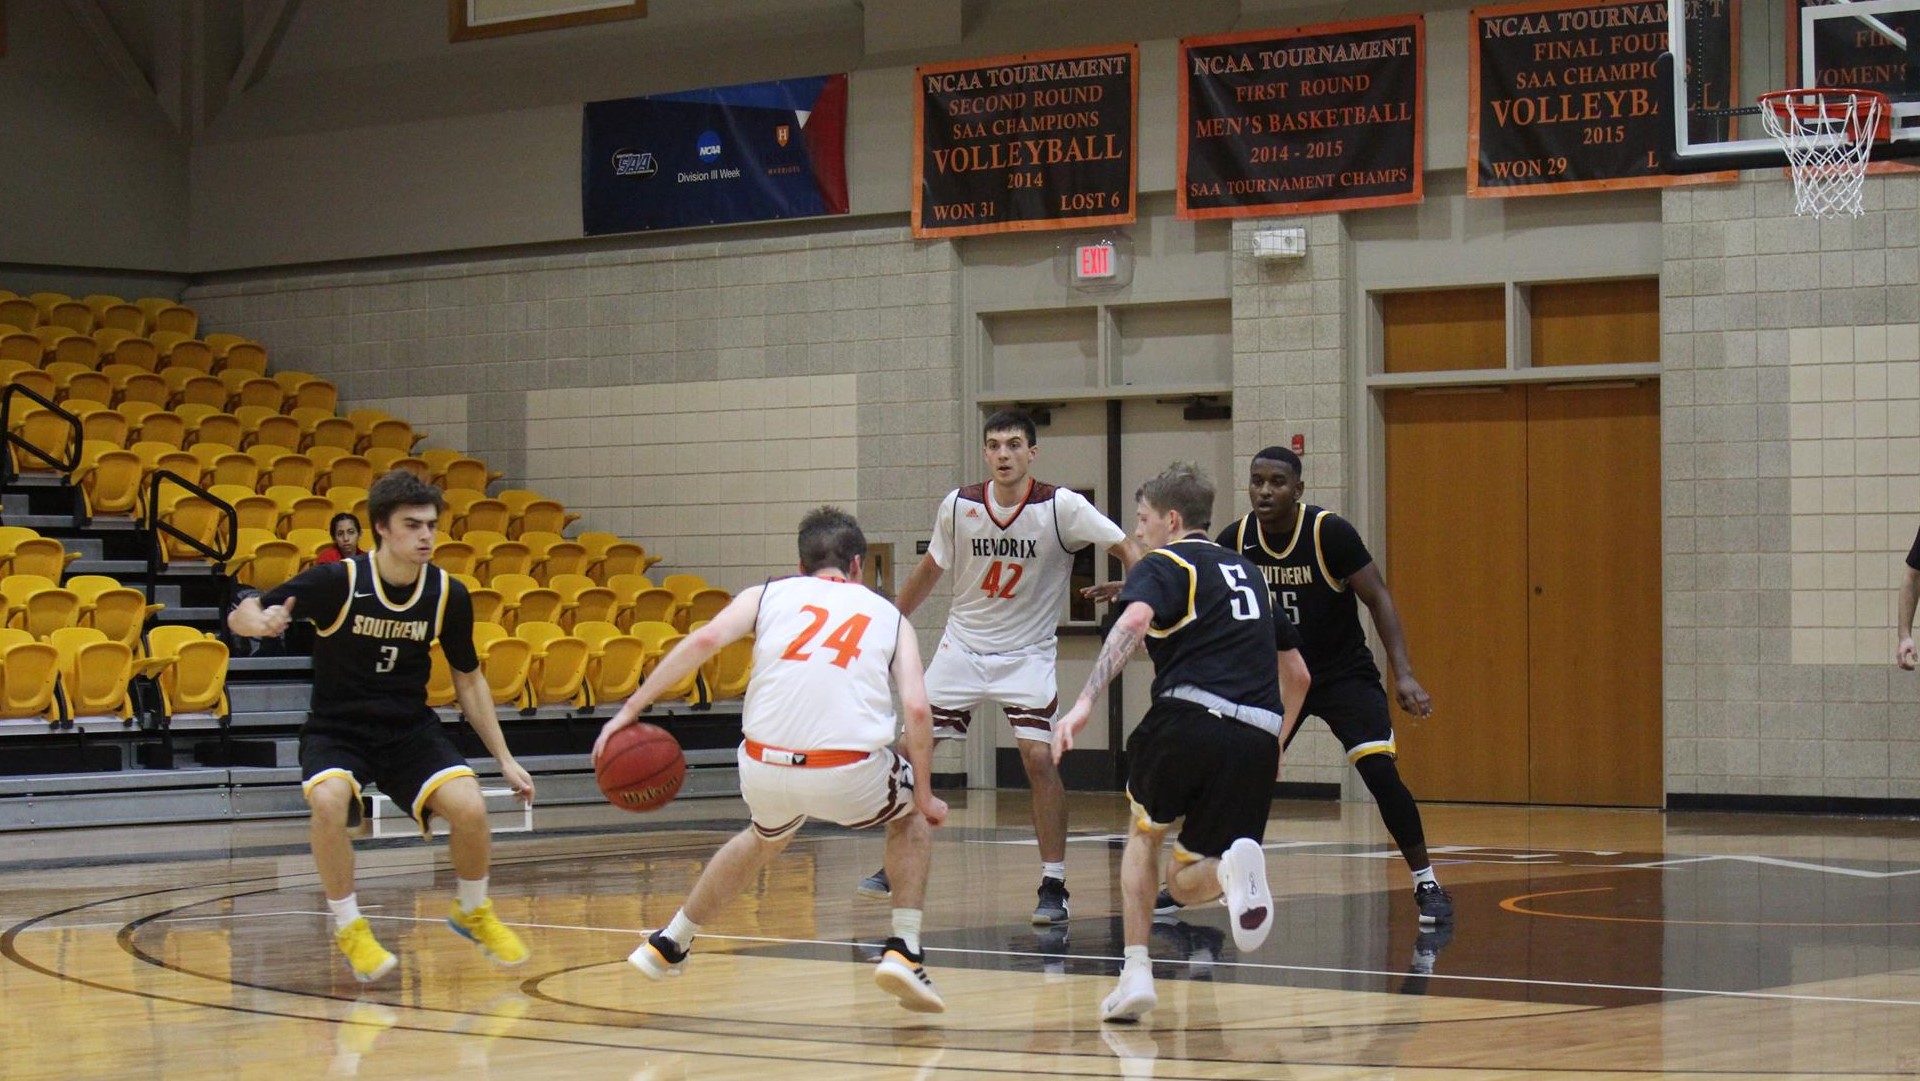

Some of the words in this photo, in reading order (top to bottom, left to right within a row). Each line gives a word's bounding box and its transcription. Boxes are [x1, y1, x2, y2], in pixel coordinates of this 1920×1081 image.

[1484, 15, 1551, 38] NCAA
[1194, 53, 1254, 75] NCAA
[1259, 37, 1411, 70] TOURNAMENT
[1533, 37, 1603, 62] FINAL
[1611, 32, 1669, 54] FOUR
[928, 72, 983, 94] NCAA
[987, 56, 1126, 88] TOURNAMENT
[1236, 82, 1288, 102] FIRST
[1300, 74, 1371, 97] ROUND
[1516, 71, 1557, 90] SAA
[1563, 58, 1692, 86] CHAMPIS
[1814, 63, 1907, 87] OMEN'S
[950, 92, 1026, 116] SECOND
[1034, 85, 1103, 107] ROUND
[1490, 82, 1720, 128] VOLLEYBL
[953, 121, 987, 140] SAA
[992, 111, 1099, 136] CHAMPIONS
[1195, 114, 1263, 138] MEN'S
[1268, 102, 1412, 133] BASKETBALL
[1583, 126, 1625, 144] 2015
[617, 154, 651, 175] SAA
[700, 145, 721, 156] NCAA
[933, 133, 1123, 175] VOLLEYBALL
[1250, 145, 1288, 163] 2014
[1306, 140, 1343, 159] 2015
[677, 171, 709, 183] Division
[710, 169, 718, 180] III
[719, 168, 741, 179] Week
[1007, 172, 1043, 189] 2014
[1190, 182, 1221, 197] SAA
[1226, 174, 1335, 195] TOURNAMENT
[1340, 167, 1407, 186] CHAMPS
[1493, 160, 1542, 179] WON
[1547, 157, 1567, 175] 29
[933, 203, 975, 221] WON
[980, 201, 995, 217] 31
[1061, 192, 1106, 211] LOST
[1111, 191, 1120, 208] 6
[1082, 247, 1109, 274] EXIT
[972, 538, 1037, 559] HENDRIX
[980, 560, 1024, 600] 42
[1257, 565, 1313, 585] UTHERN
[1218, 562, 1260, 621] 5
[1270, 591, 1301, 625] 5
[780, 604, 872, 670] 24
[376, 645, 399, 673] 3
